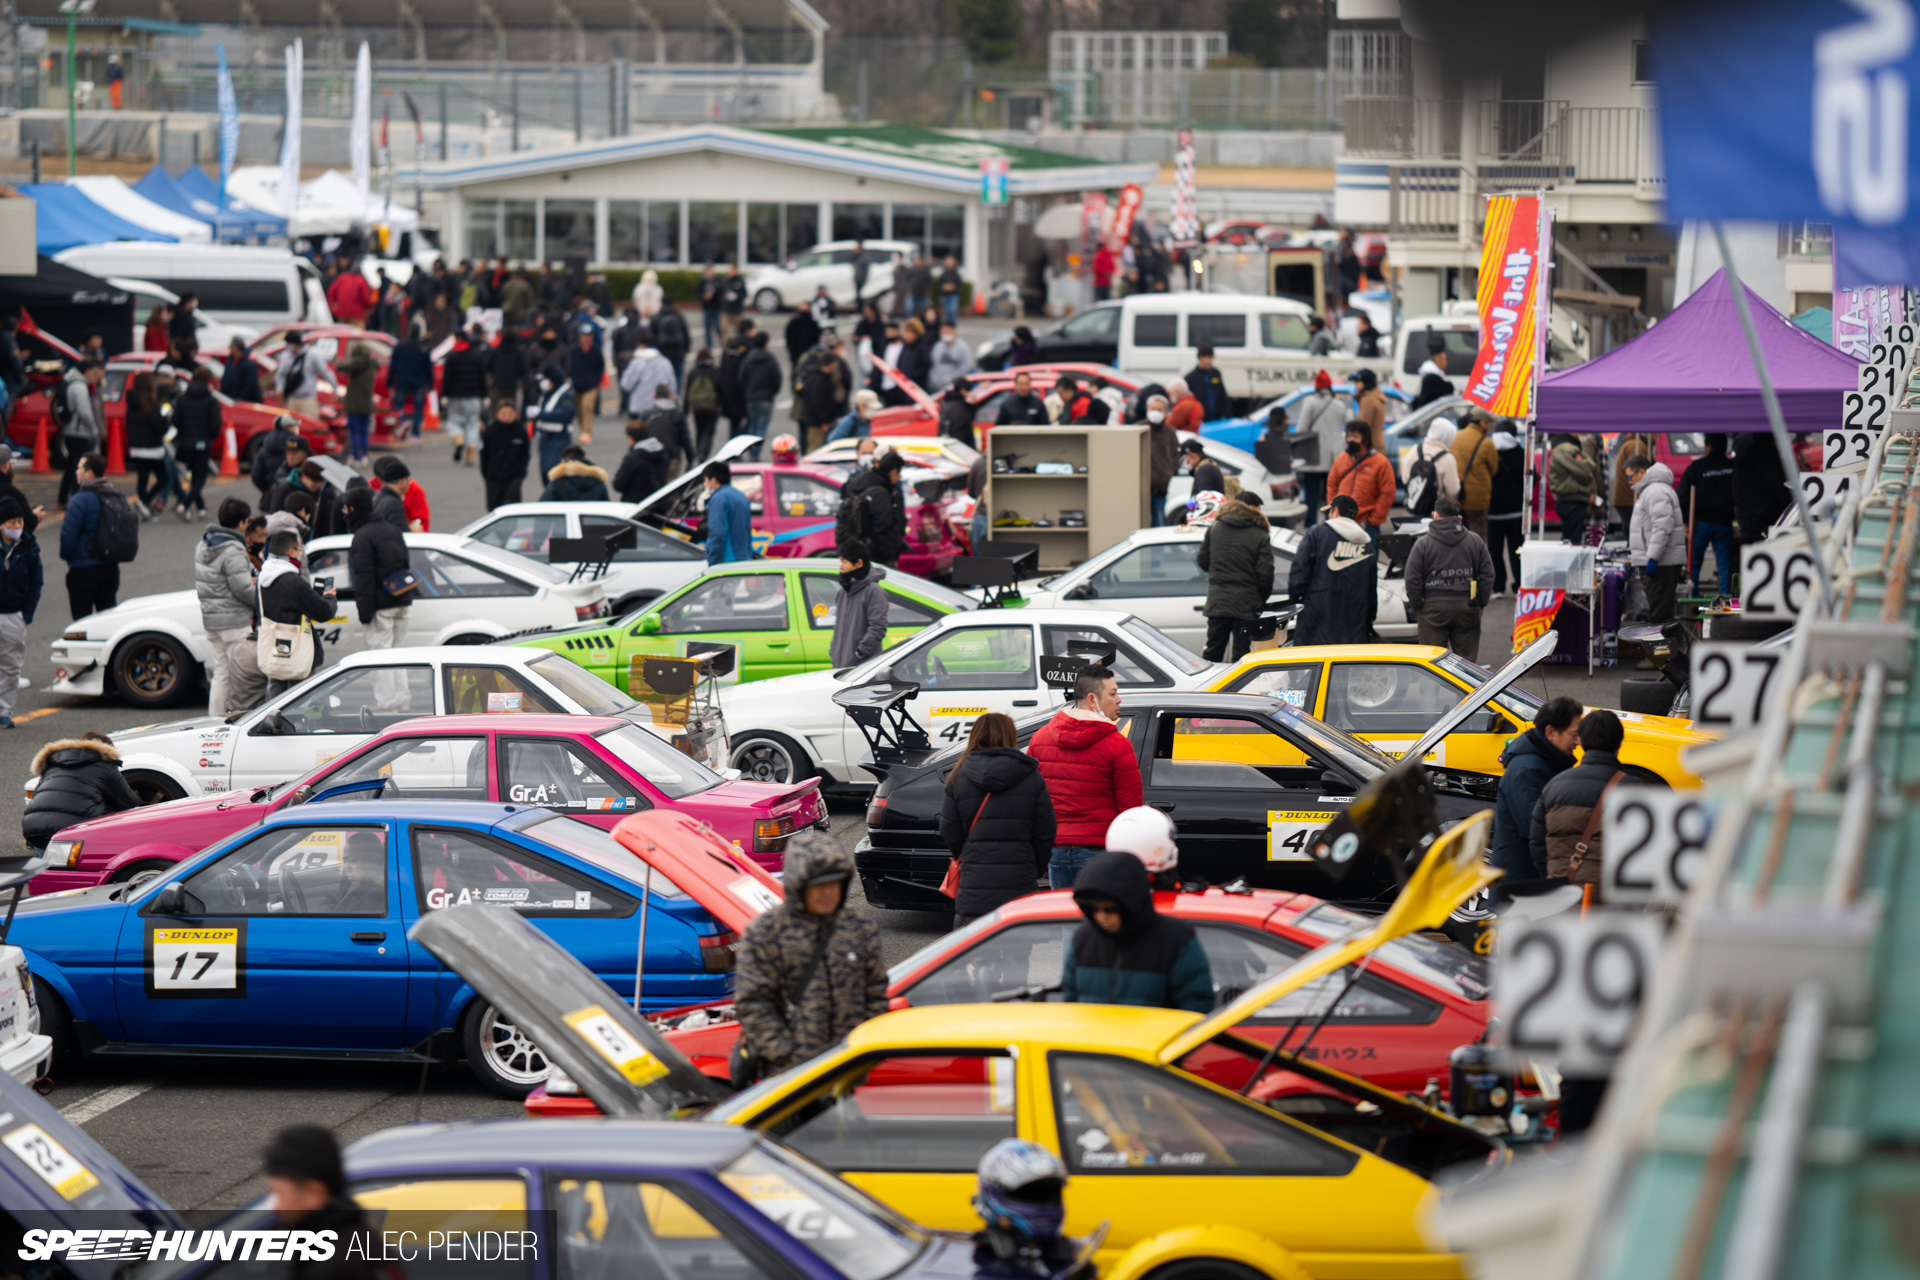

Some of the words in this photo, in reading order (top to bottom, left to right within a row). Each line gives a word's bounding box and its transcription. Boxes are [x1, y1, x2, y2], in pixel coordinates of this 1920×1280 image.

[1884, 324, 1914, 344] 19
[1872, 344, 1906, 372] 20
[1863, 366, 1895, 396] 21
[1844, 393, 1886, 430] 22
[1825, 432, 1871, 469] 23
[1334, 541, 1367, 558] NIKE
[1746, 552, 1813, 614] 26
[1698, 652, 1780, 724] 27
[1614, 800, 1707, 892] 28
[170, 931, 234, 939] DUNLOP
[170, 951, 220, 981] 17
[1508, 929, 1644, 1055] 29
